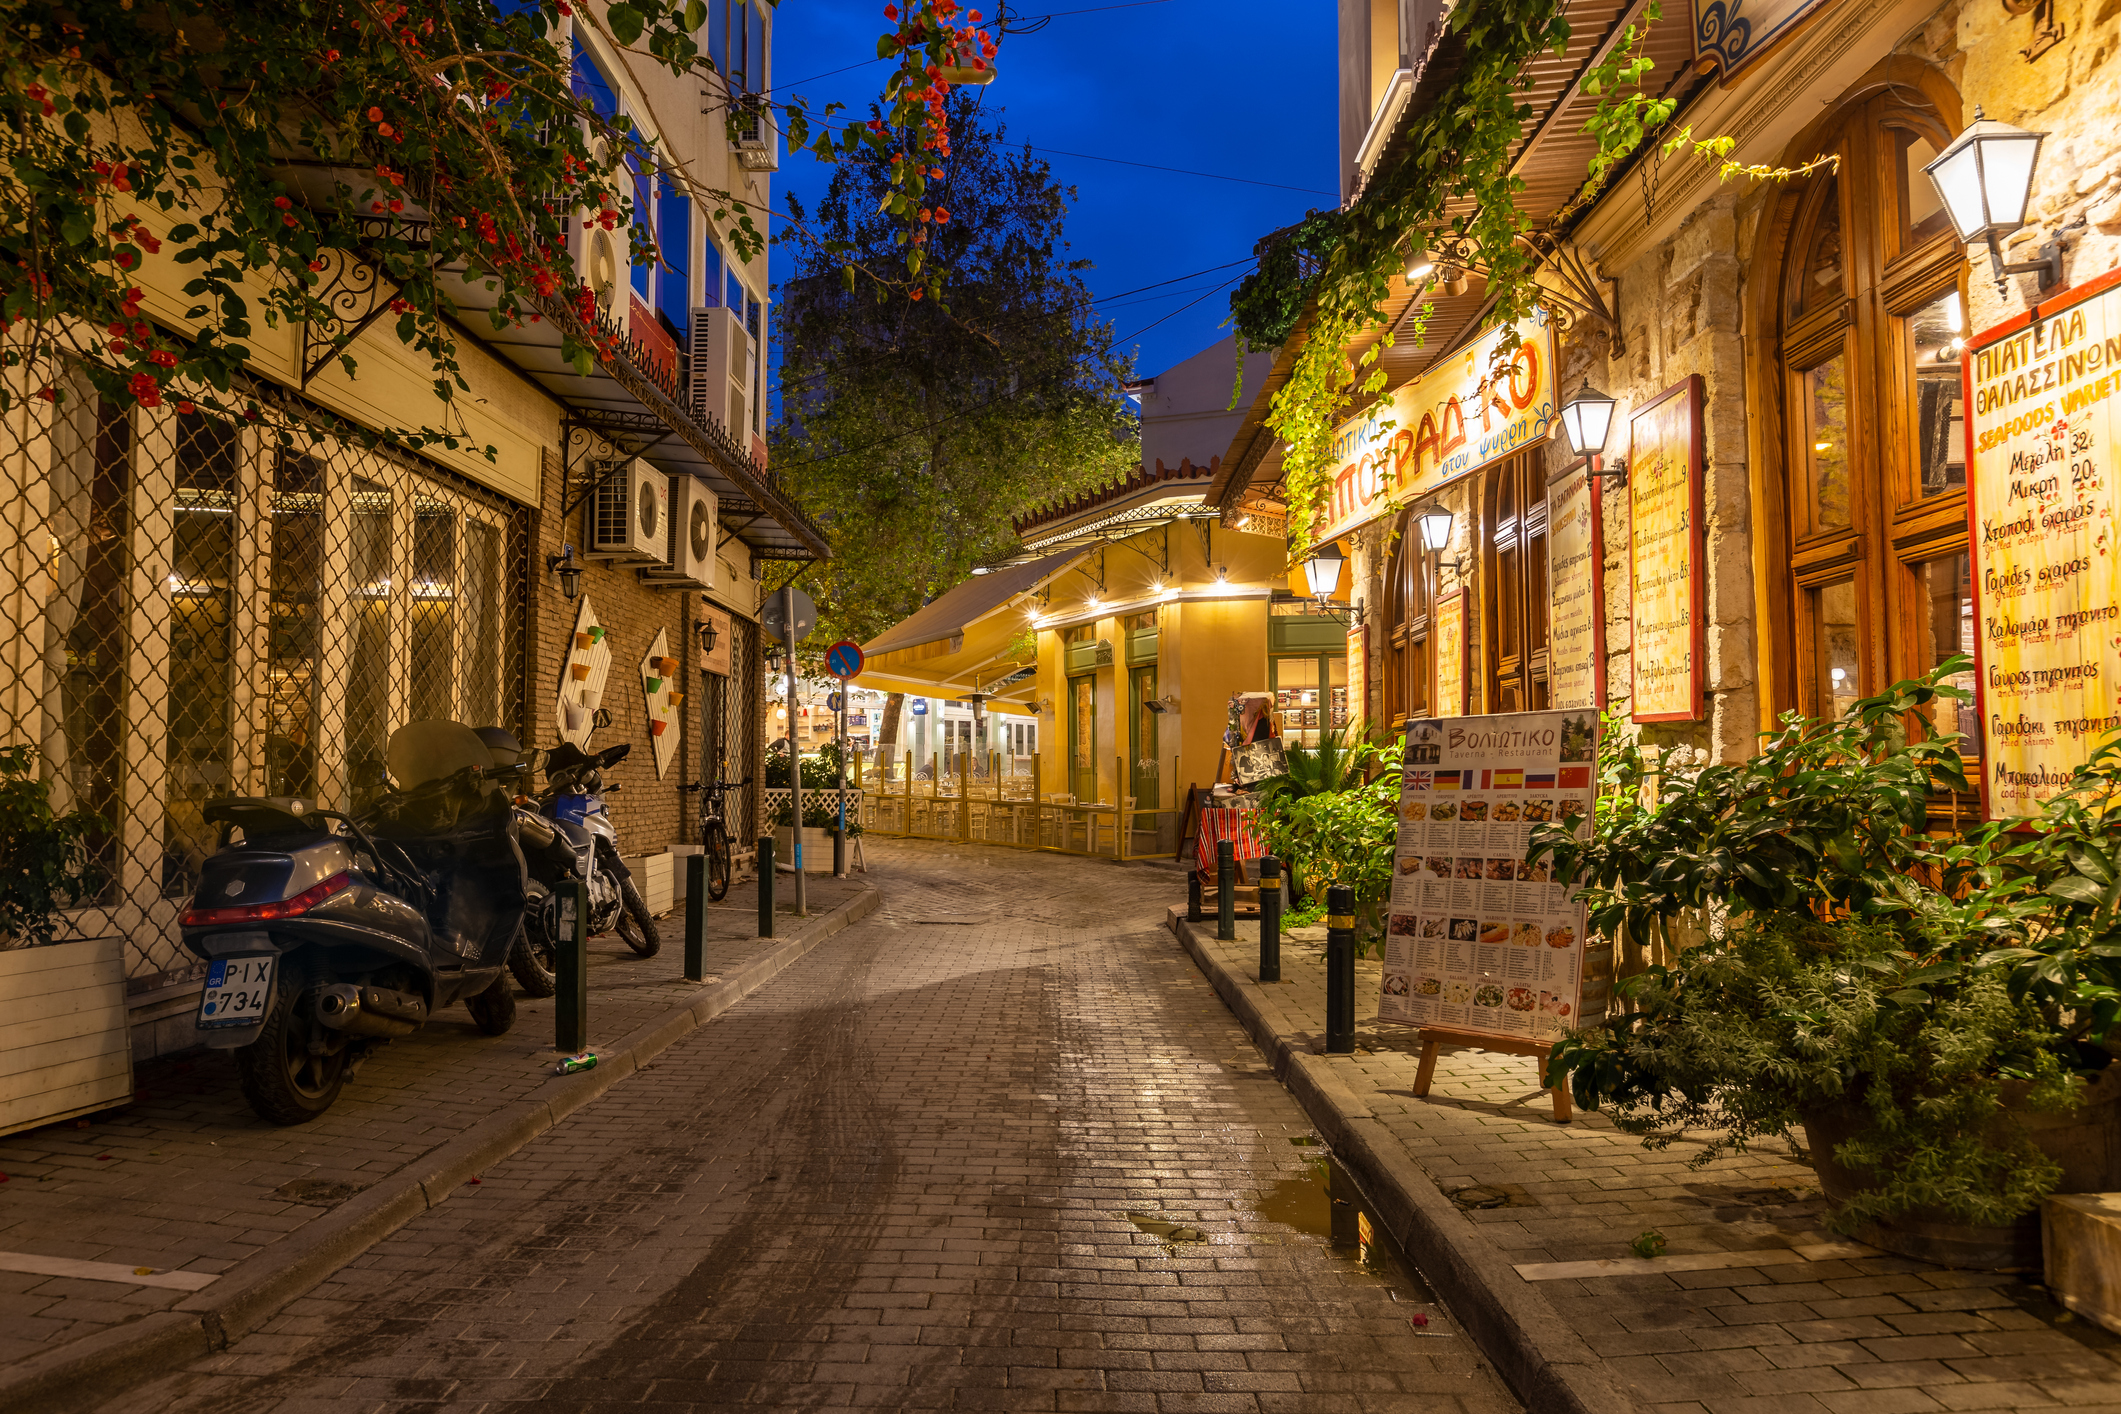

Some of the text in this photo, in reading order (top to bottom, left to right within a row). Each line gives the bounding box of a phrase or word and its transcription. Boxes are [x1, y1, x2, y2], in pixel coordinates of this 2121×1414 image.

[1450, 750, 1485, 759] Taverna
[1498, 748, 1553, 757] Restaurant
[1995, 762, 2076, 791] Μπακαλιάρο
[224, 962, 269, 985] PIX
[220, 990, 262, 1013] 734
